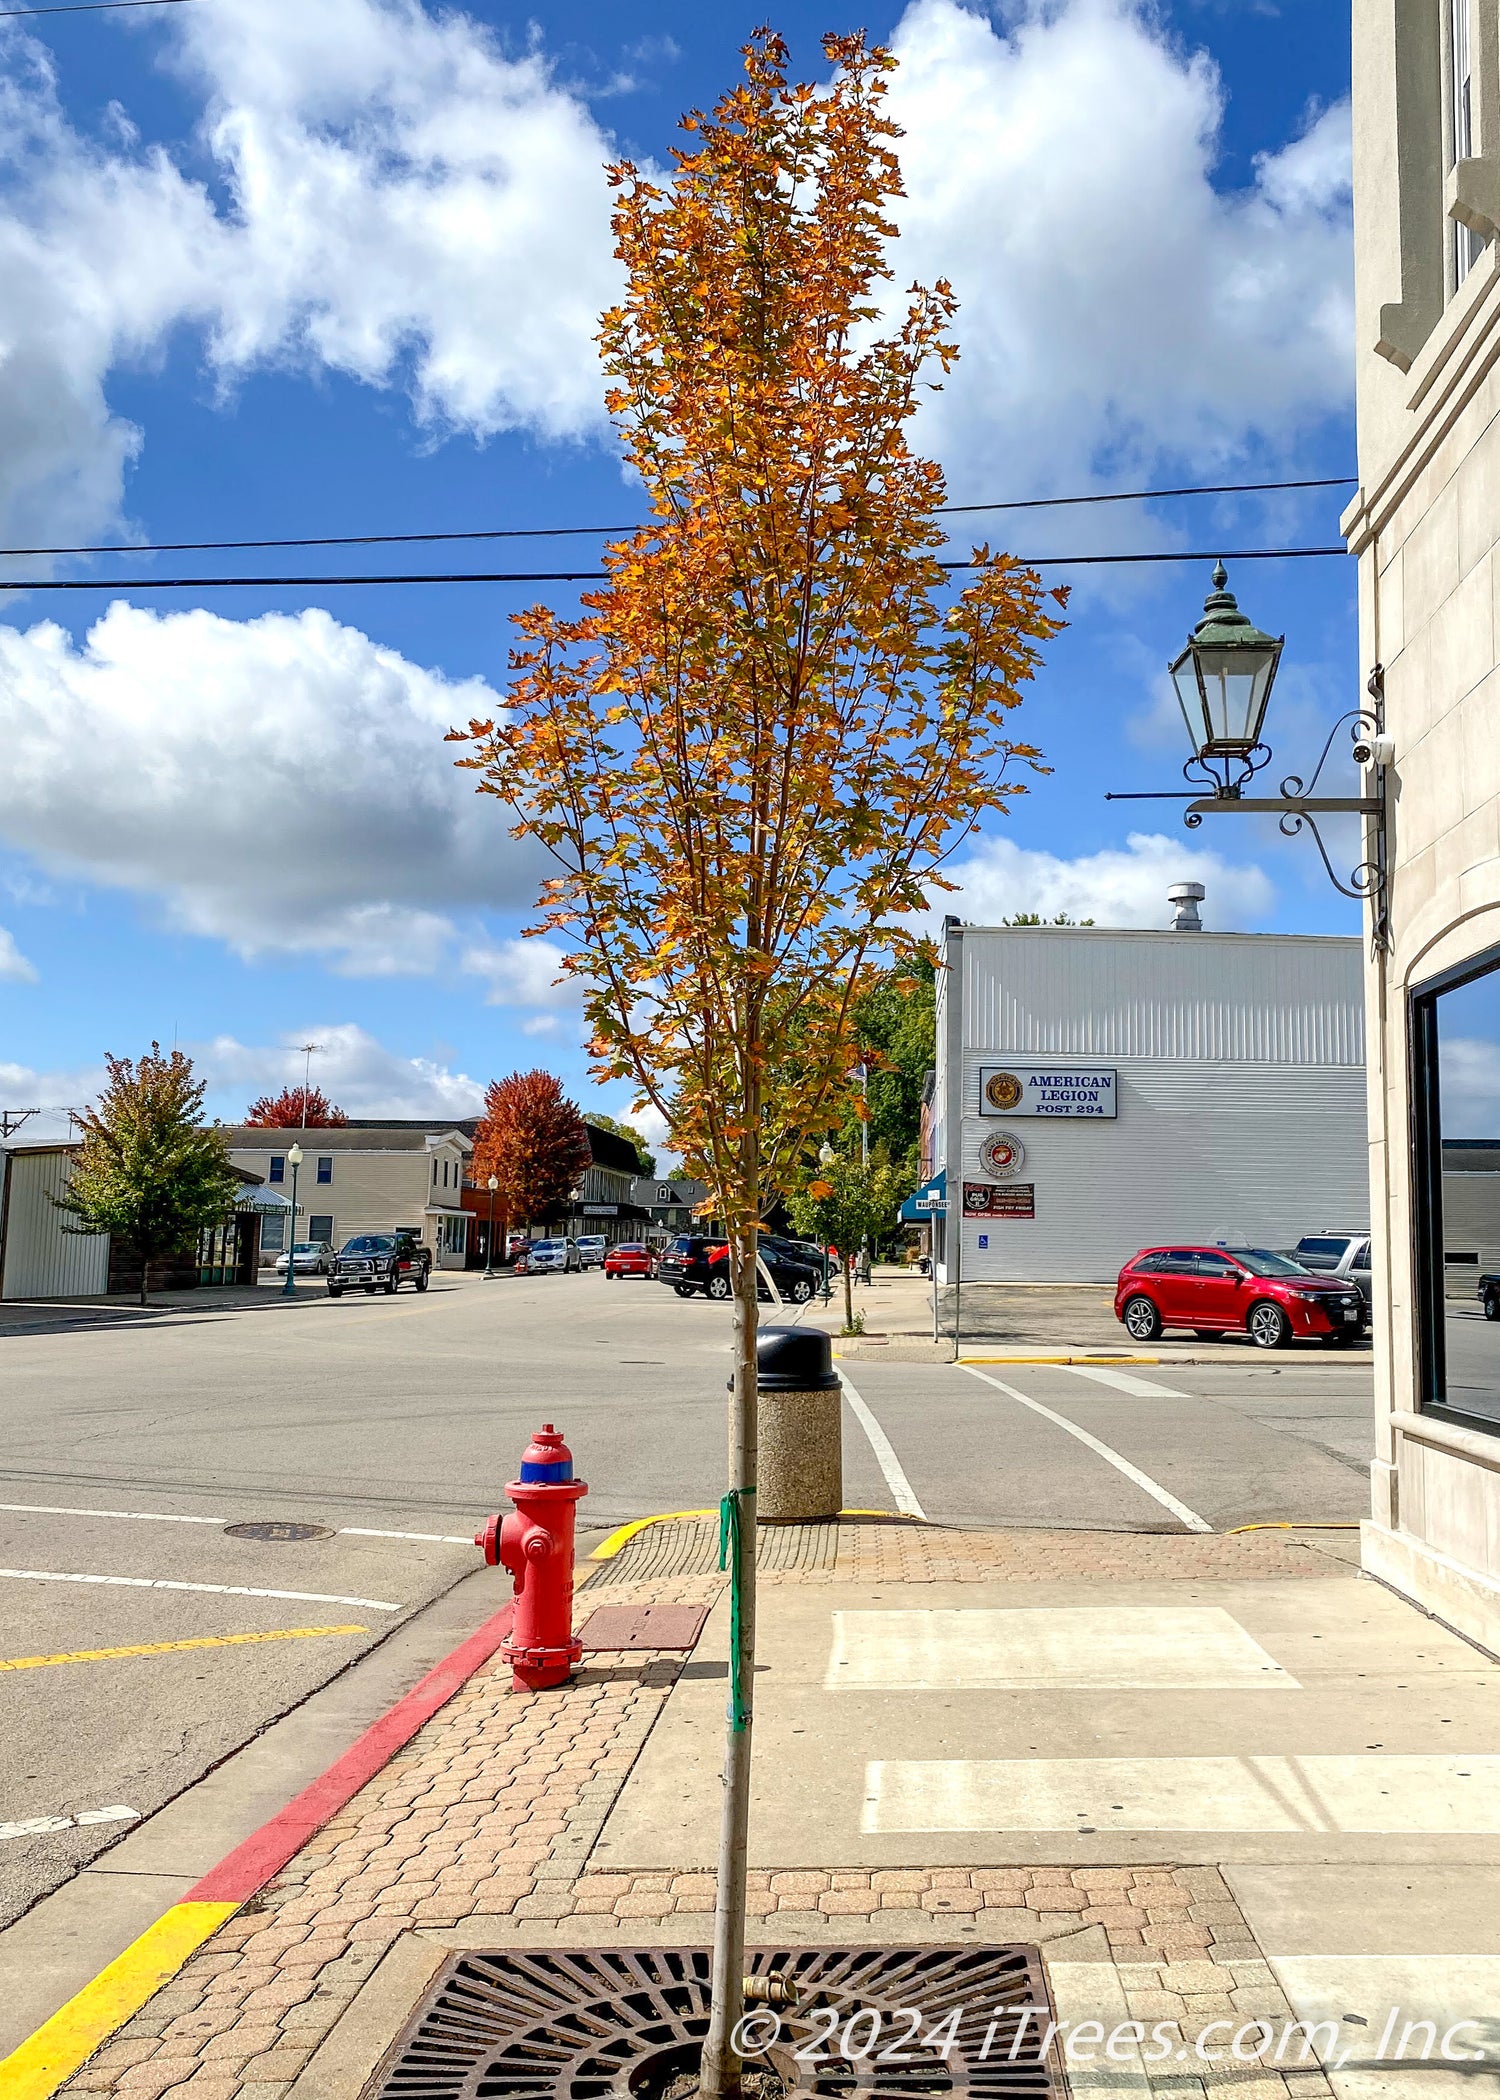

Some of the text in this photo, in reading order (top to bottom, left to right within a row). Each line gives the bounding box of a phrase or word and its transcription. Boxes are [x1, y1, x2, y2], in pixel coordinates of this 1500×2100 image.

[1028, 1076, 1112, 1088] AMERICAN
[1041, 1090, 1099, 1101] LEGION
[1036, 1105, 1104, 1113] POST 294
